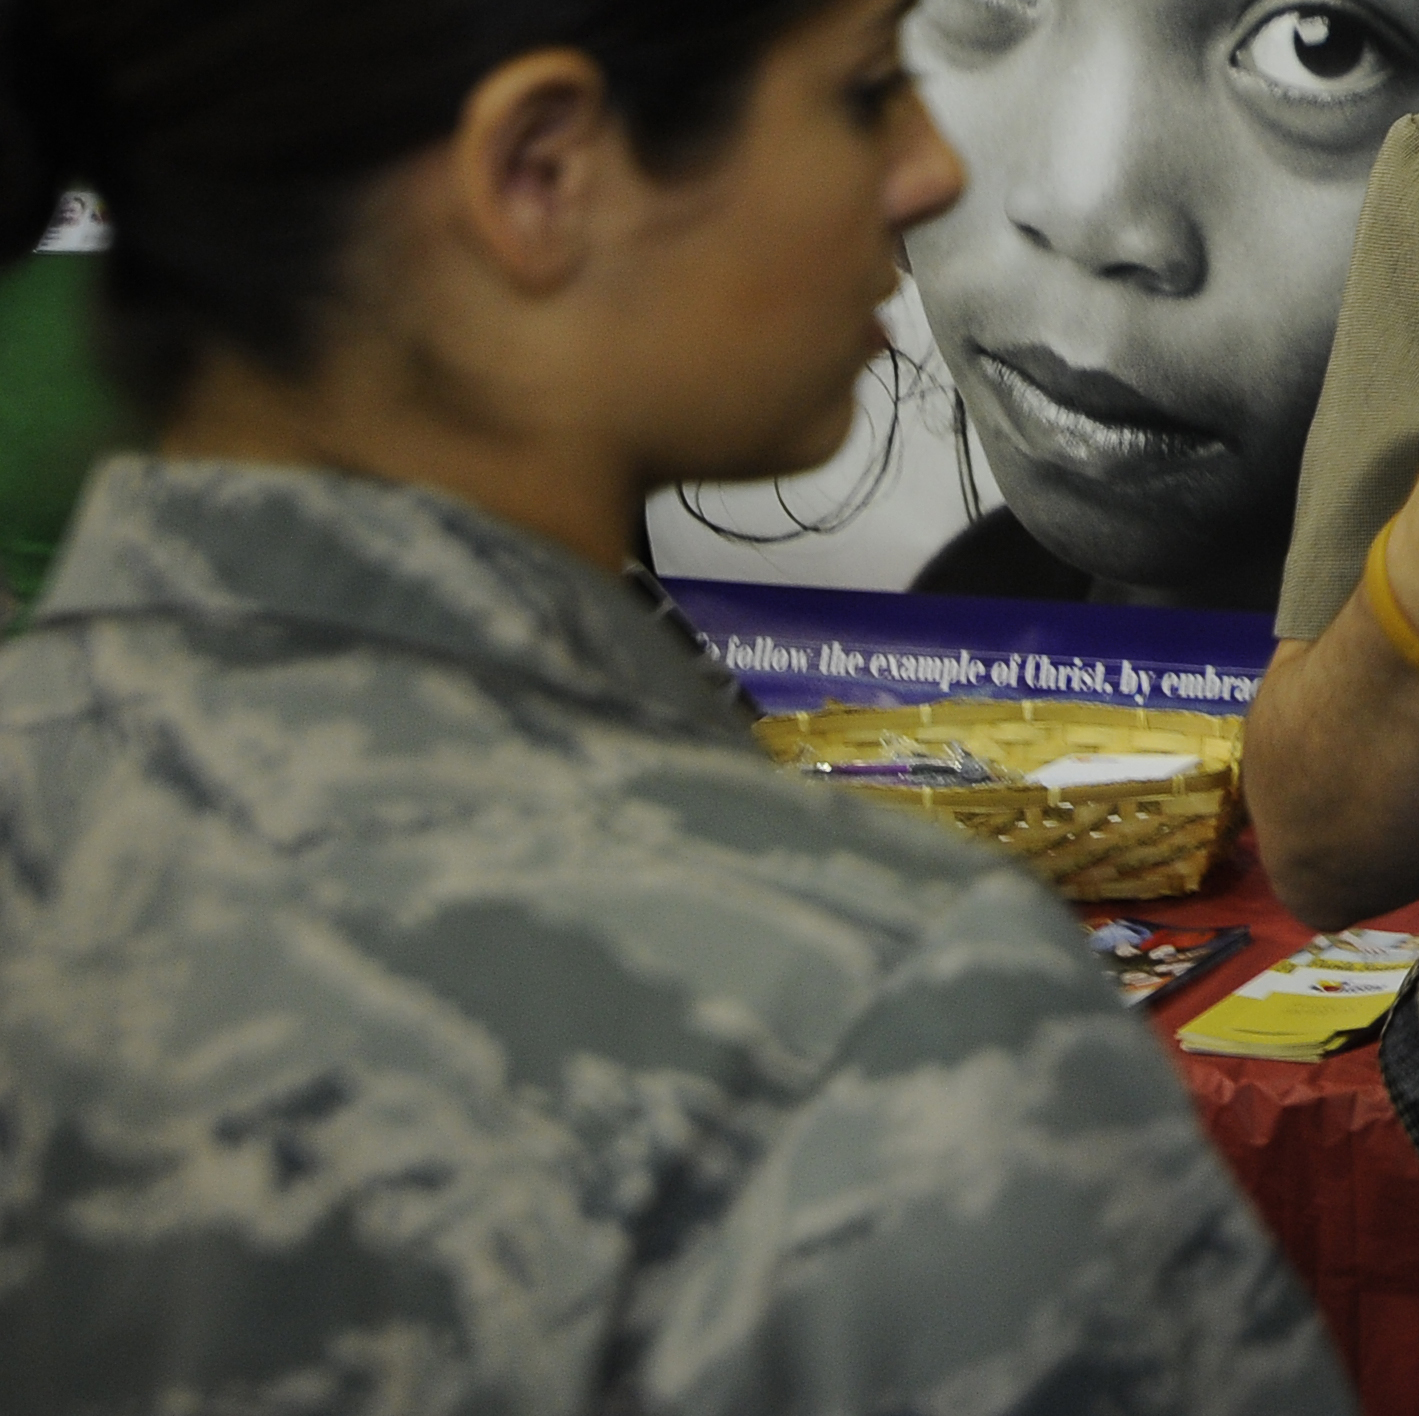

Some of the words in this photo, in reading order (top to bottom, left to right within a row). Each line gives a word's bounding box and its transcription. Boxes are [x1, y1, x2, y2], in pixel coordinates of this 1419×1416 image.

[725, 634, 813, 672] follow
[819, 640, 865, 677] the
[869, 648, 986, 693] example
[991, 652, 1021, 688] of
[1025, 653, 1113, 699] Christ,
[1119, 659, 1155, 706] by
